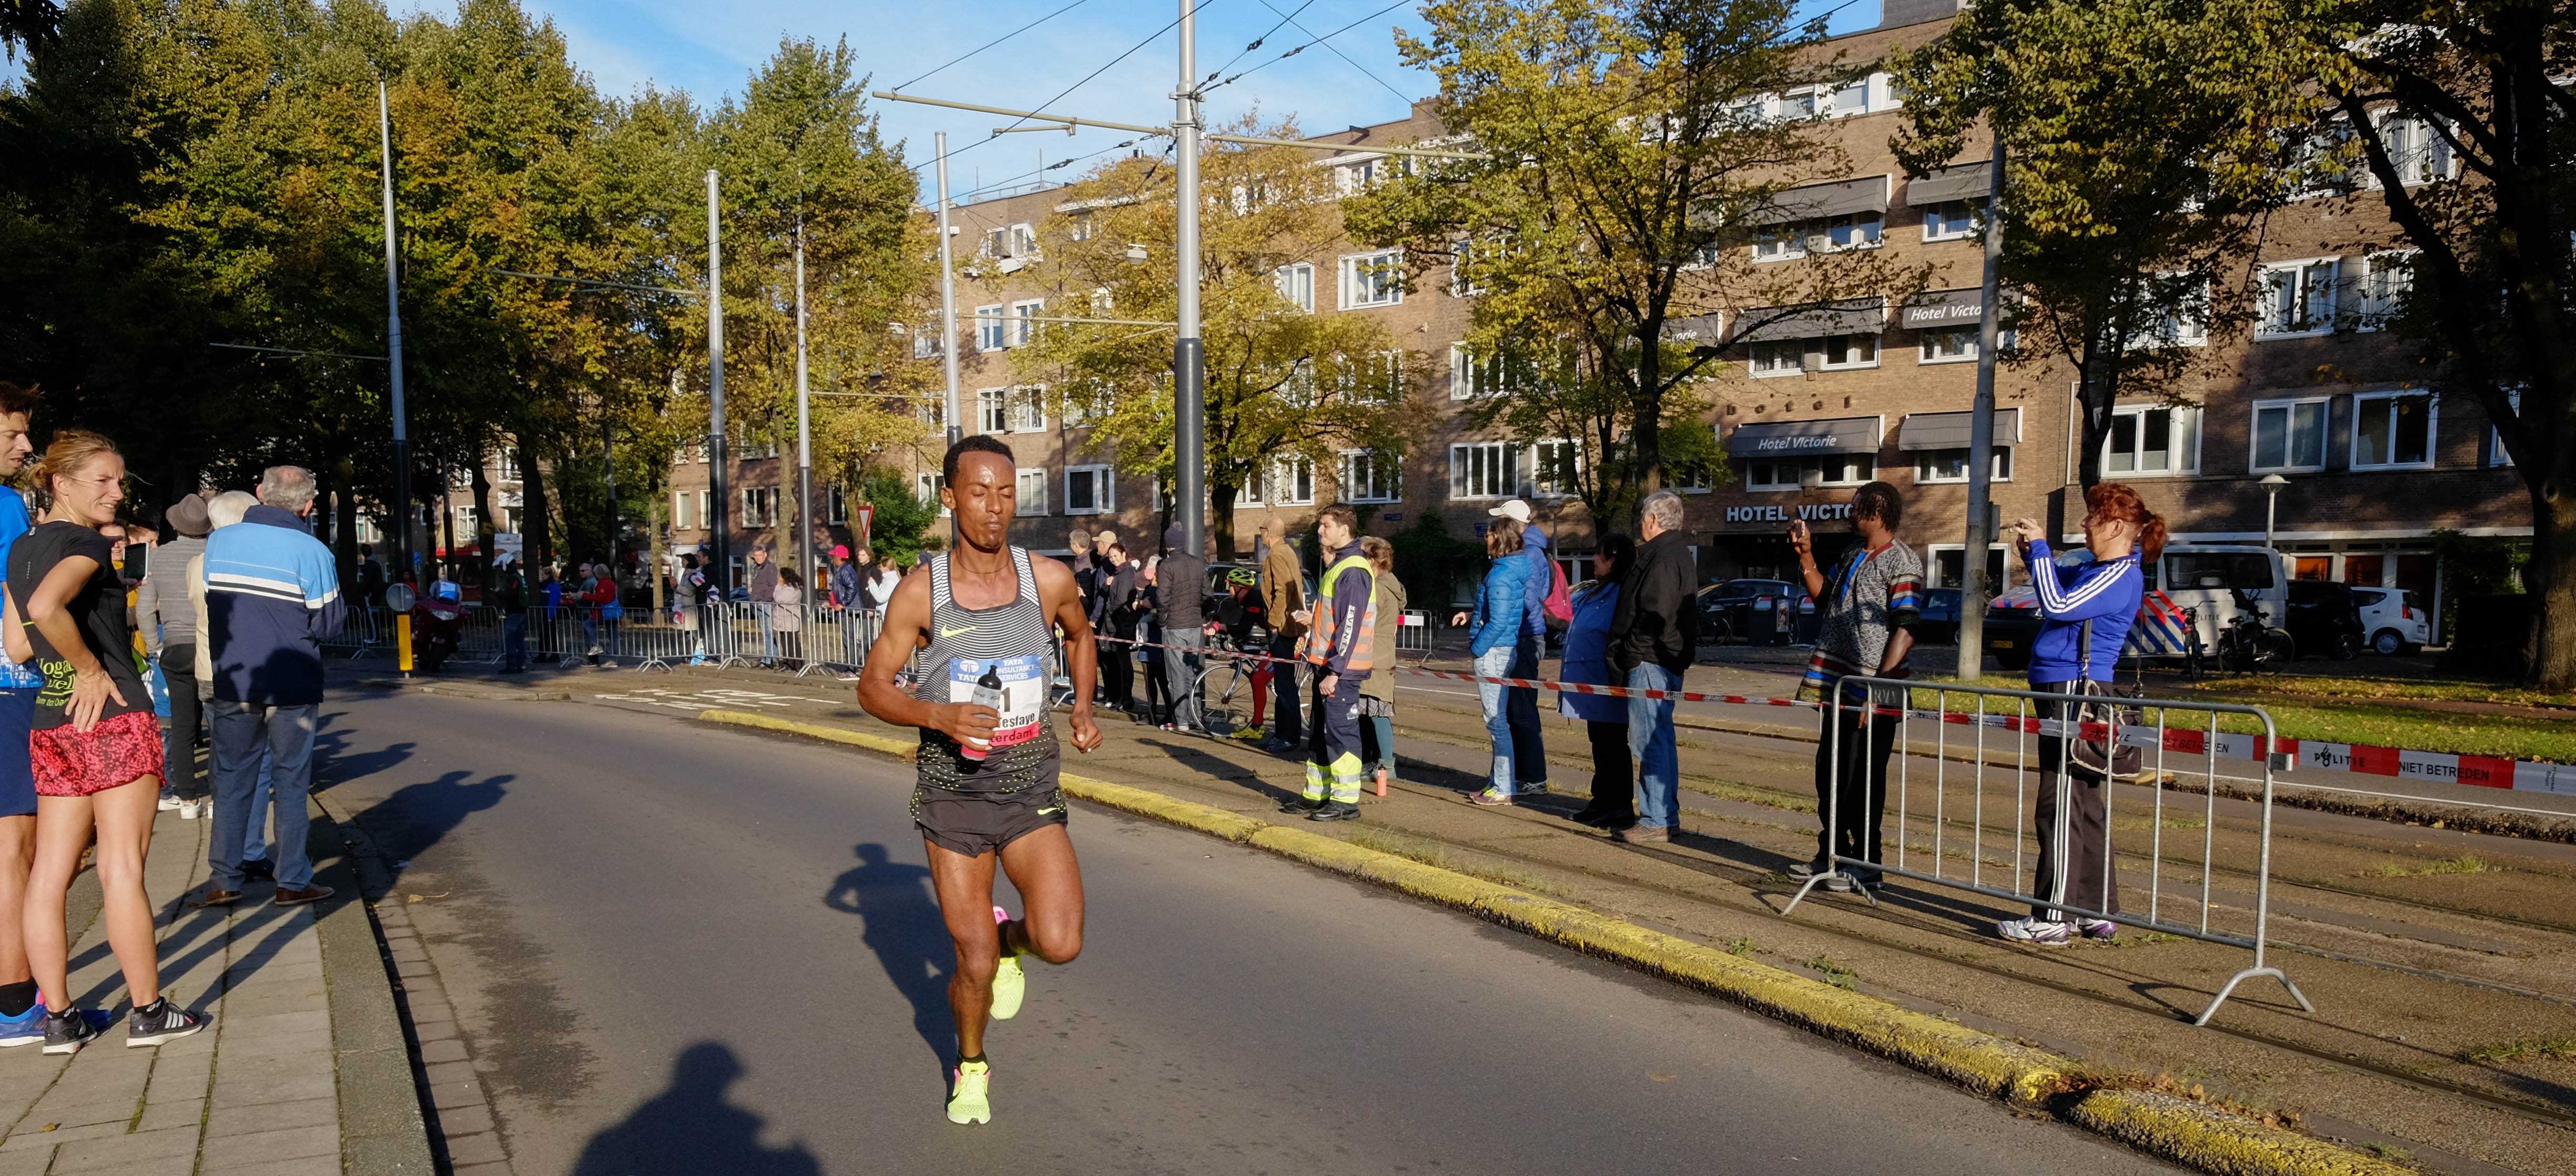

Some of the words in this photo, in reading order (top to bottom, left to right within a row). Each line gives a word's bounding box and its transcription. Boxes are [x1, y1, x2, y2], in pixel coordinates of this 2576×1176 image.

[1910, 306, 1946, 321] Hotel
[1951, 304, 1982, 317] Victo
[1758, 437, 1790, 450] Hotel
[1793, 435, 1837, 449] Victorie
[1726, 505, 1789, 522] HOTEL
[1798, 503, 1853, 520] VICTO
[998, 672, 1029, 681] SERVICES
[990, 730, 1032, 743] terdam
[2179, 739, 2229, 753] BETREEN
[2314, 746, 2365, 768] POLITIE
[2399, 761, 2423, 775] NIET
[2427, 764, 2490, 781] BETREDEN
